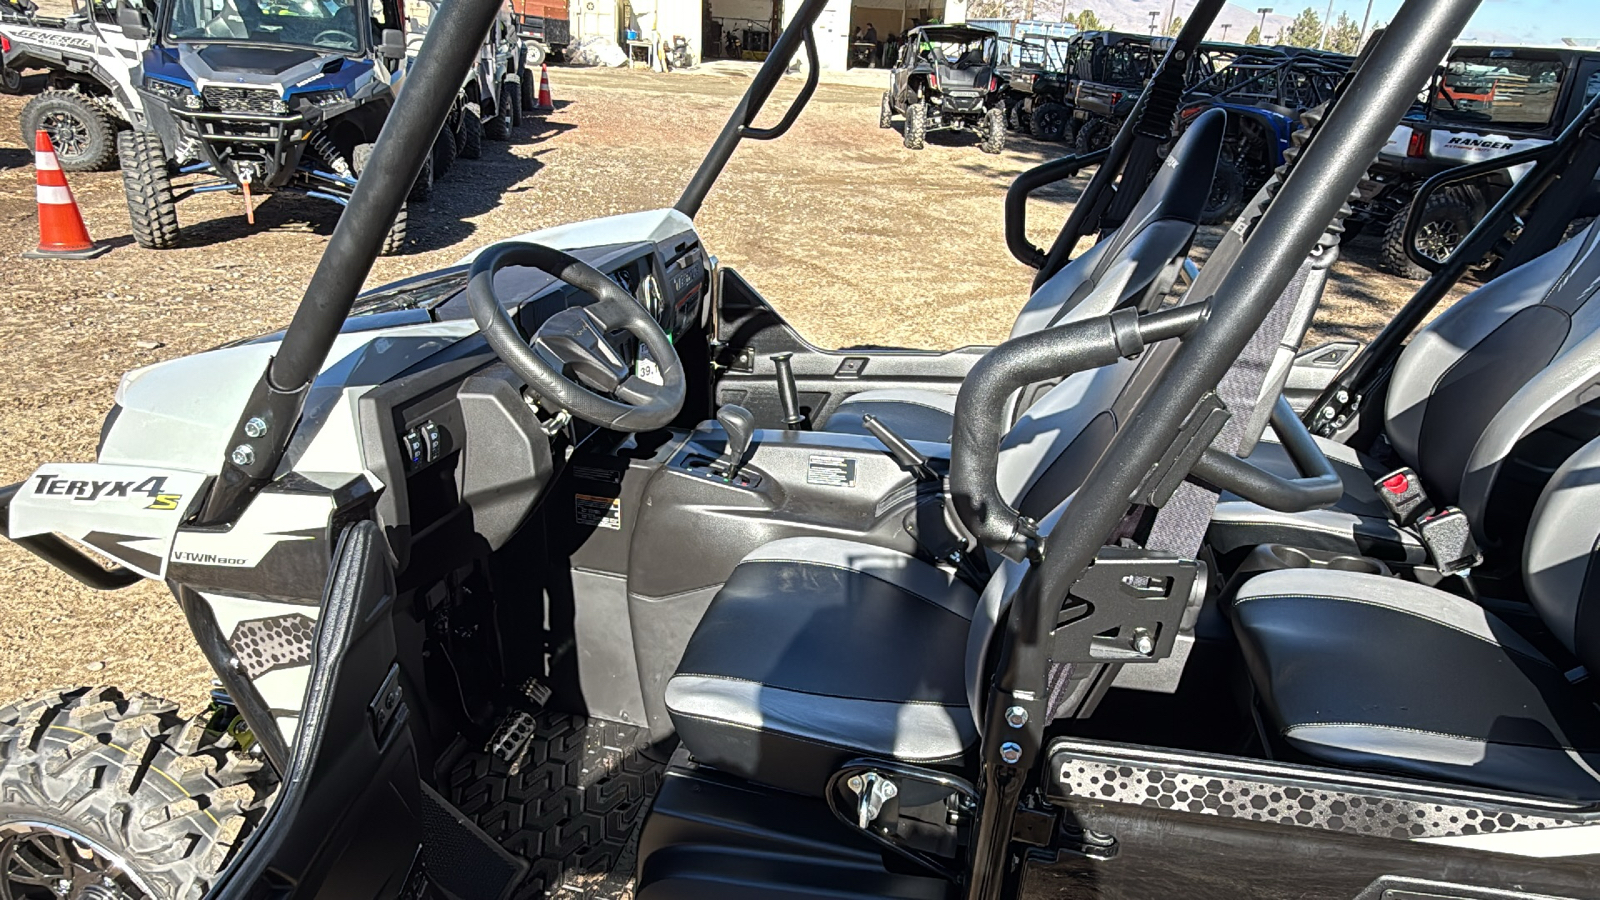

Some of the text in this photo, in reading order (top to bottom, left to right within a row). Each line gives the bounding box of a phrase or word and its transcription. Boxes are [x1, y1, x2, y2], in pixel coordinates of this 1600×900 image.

[18, 30, 90, 47] GENERAL
[1448, 137, 1513, 149] RANGER
[174, 551, 247, 565] V-TWIN 800
